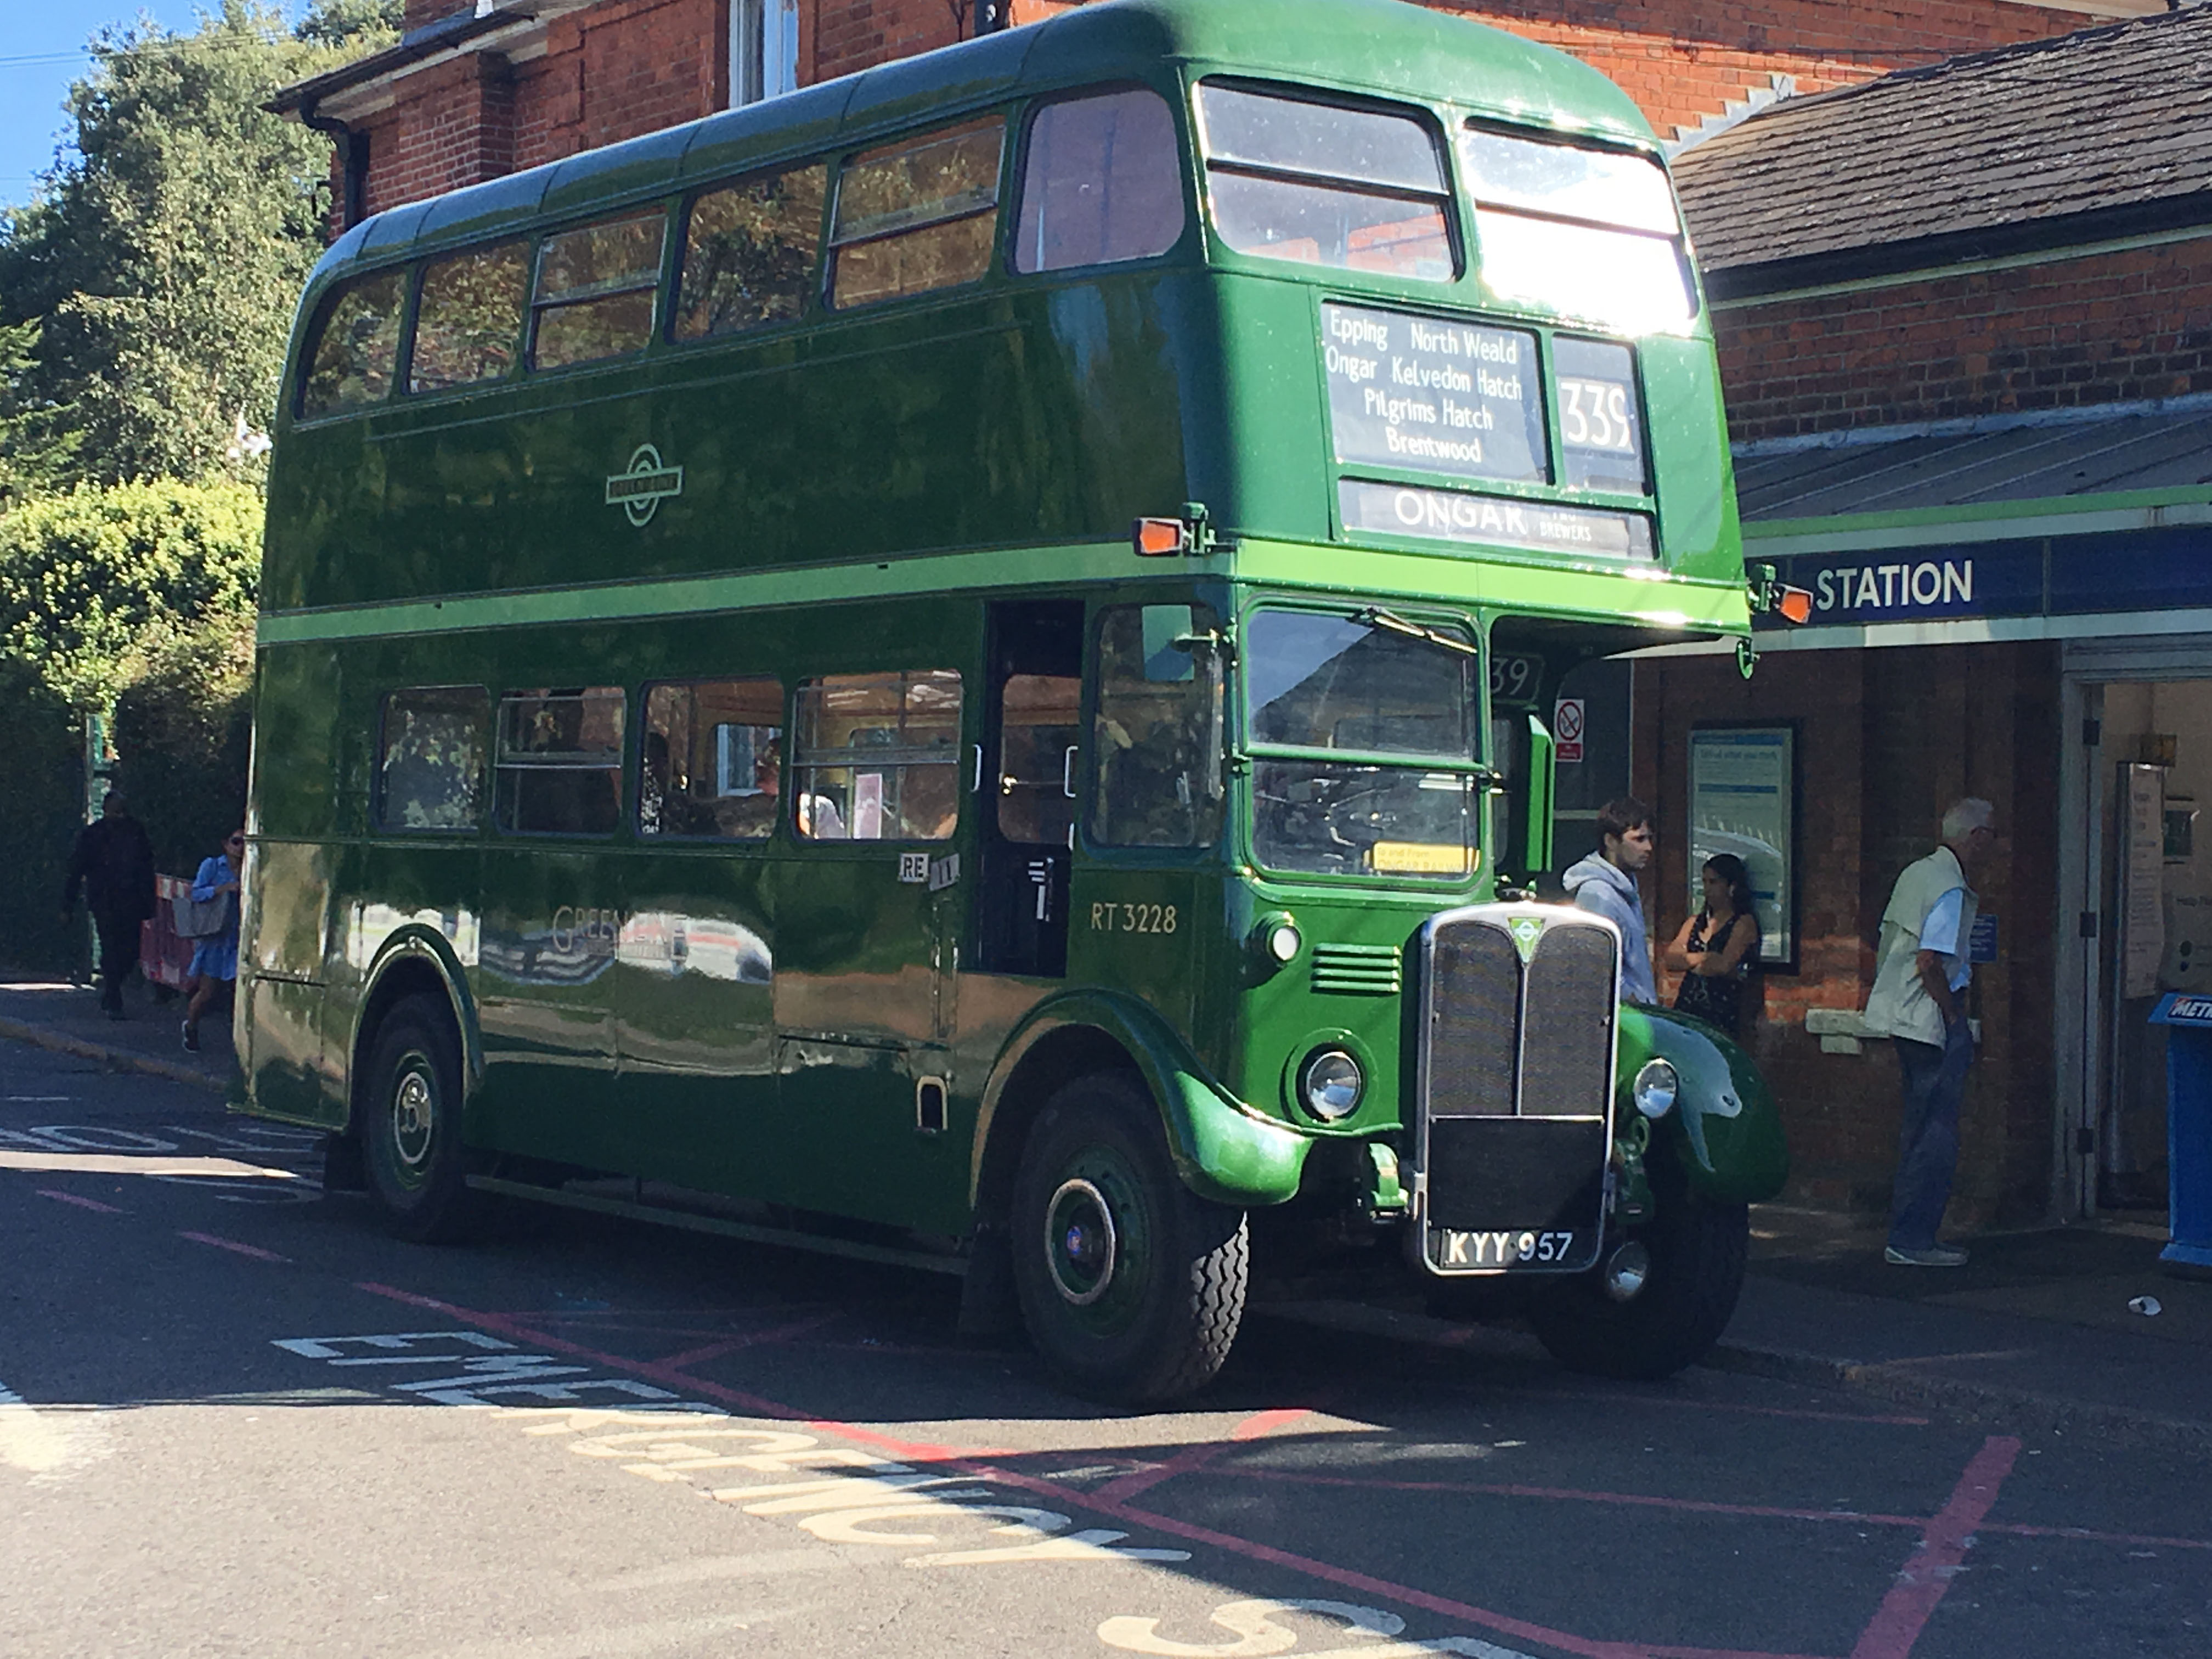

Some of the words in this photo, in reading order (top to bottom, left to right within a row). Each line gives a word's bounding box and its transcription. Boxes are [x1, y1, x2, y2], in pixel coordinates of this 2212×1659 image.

[1330, 309, 1388, 352] Epping
[1410, 322, 1458, 356] North
[1463, 330, 1517, 365] Weald
[1325, 345, 1378, 383] Ongar
[1392, 356, 1471, 393] Kelvedon
[1477, 368, 1522, 401] Hatch
[1364, 388, 1437, 425] Pilgrims
[1442, 398, 1493, 431] Hatch
[1561, 382, 1630, 447] 339
[1385, 426, 1482, 463] Brentwood
[1816, 560, 1973, 611] STATION
[904, 856, 924, 878] RE
[1091, 902, 1118, 930] RT
[1122, 904, 1177, 933] 3228
[1449, 1232, 1510, 1263] KYY
[1519, 1232, 1573, 1261] 957
